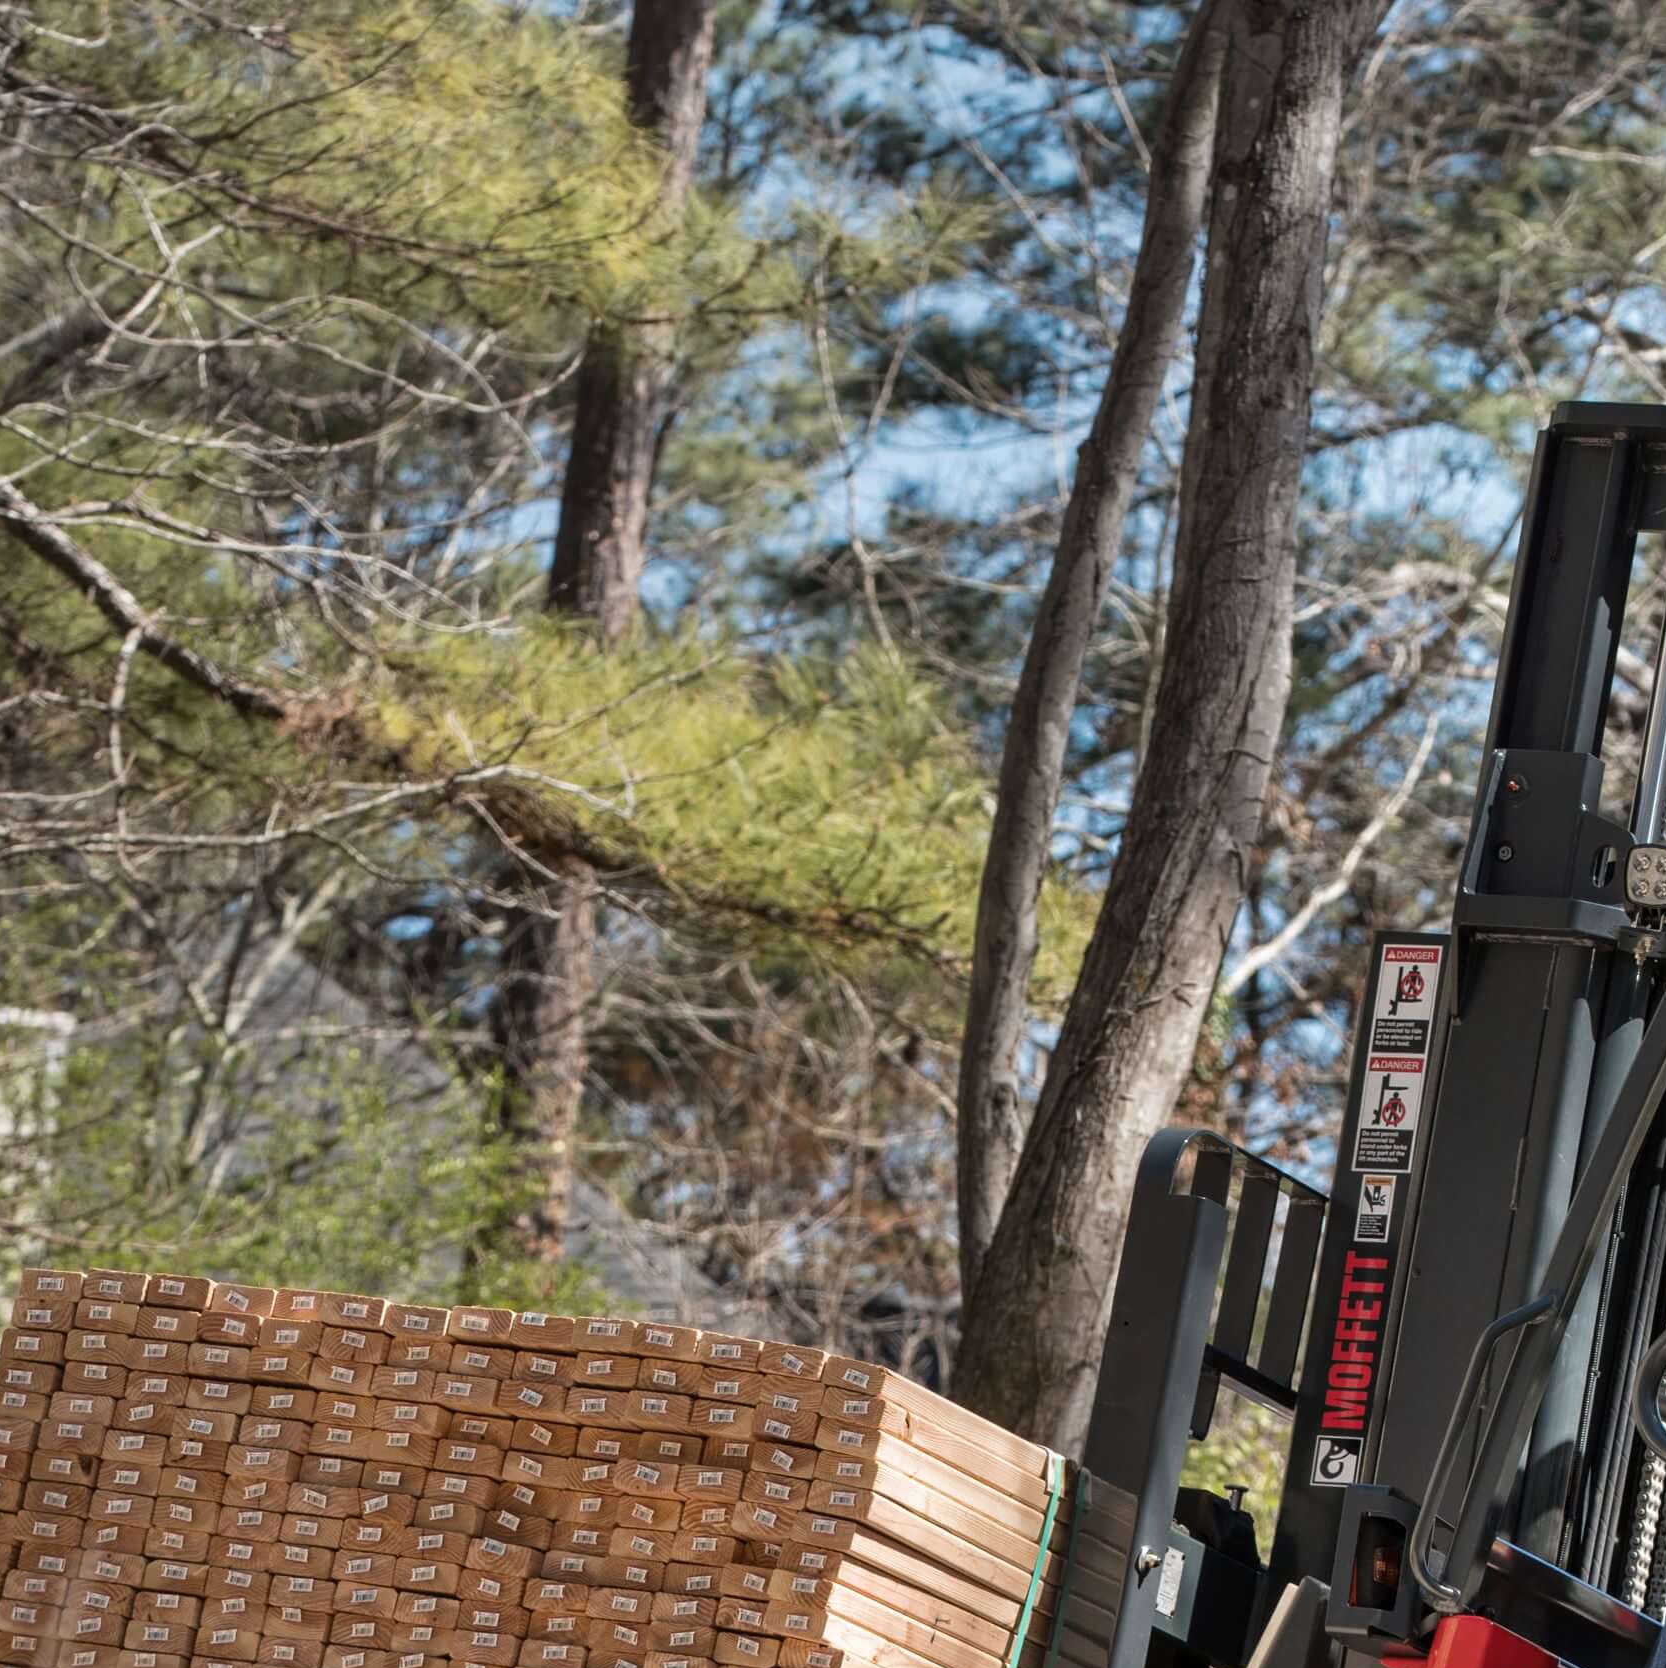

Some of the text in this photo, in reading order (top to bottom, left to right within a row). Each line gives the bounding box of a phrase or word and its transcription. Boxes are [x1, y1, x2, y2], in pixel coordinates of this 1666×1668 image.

[1396, 951, 1434, 960] DANGER
[1380, 1060, 1419, 1070] DANGER
[1321, 1250, 1389, 1431] MOFFETT
